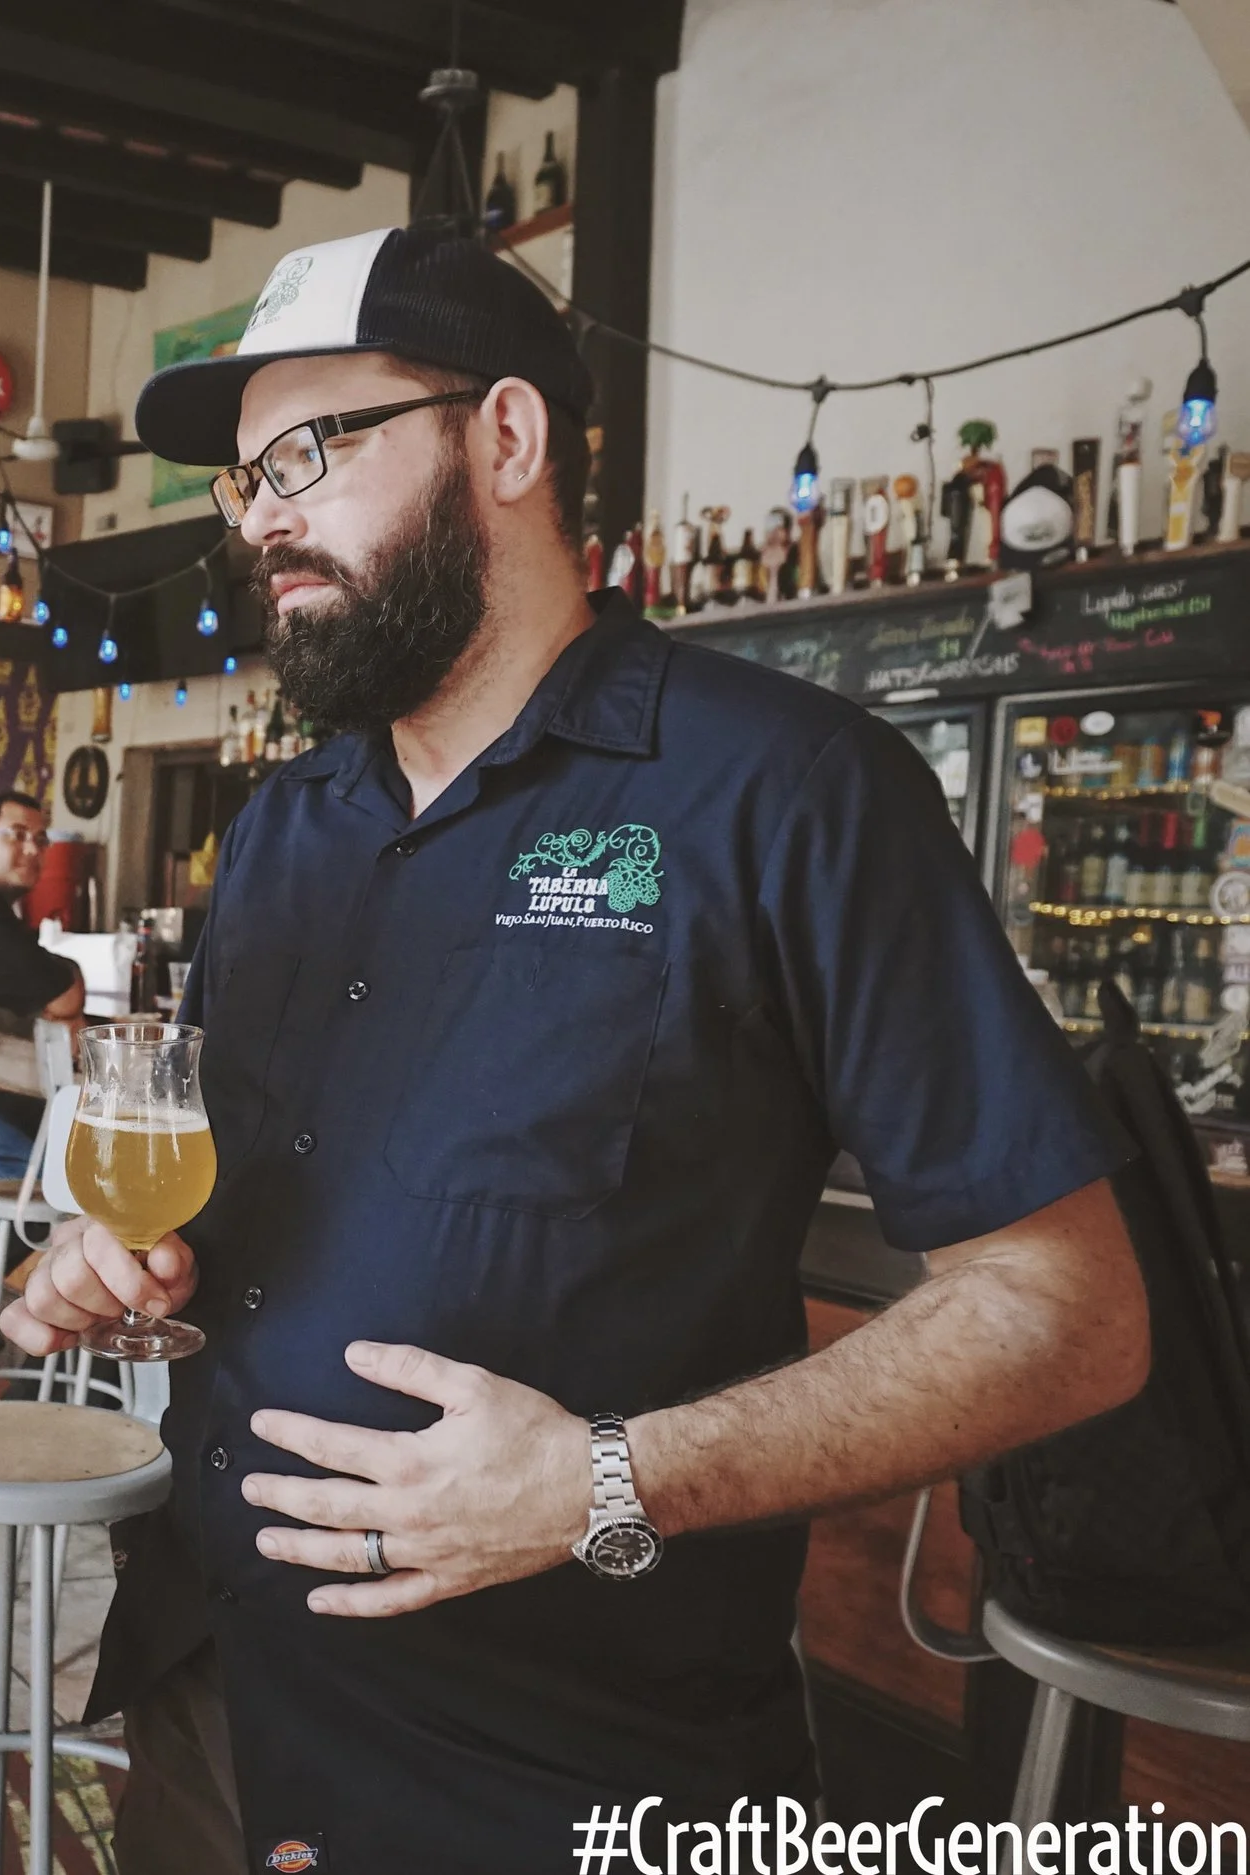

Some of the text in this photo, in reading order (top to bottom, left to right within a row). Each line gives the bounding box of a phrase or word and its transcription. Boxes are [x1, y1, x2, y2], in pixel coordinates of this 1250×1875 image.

[562, 867, 578, 877] LA
[529, 876, 608, 895] TABERNA
[271, 1851, 313, 1863] Dickies
